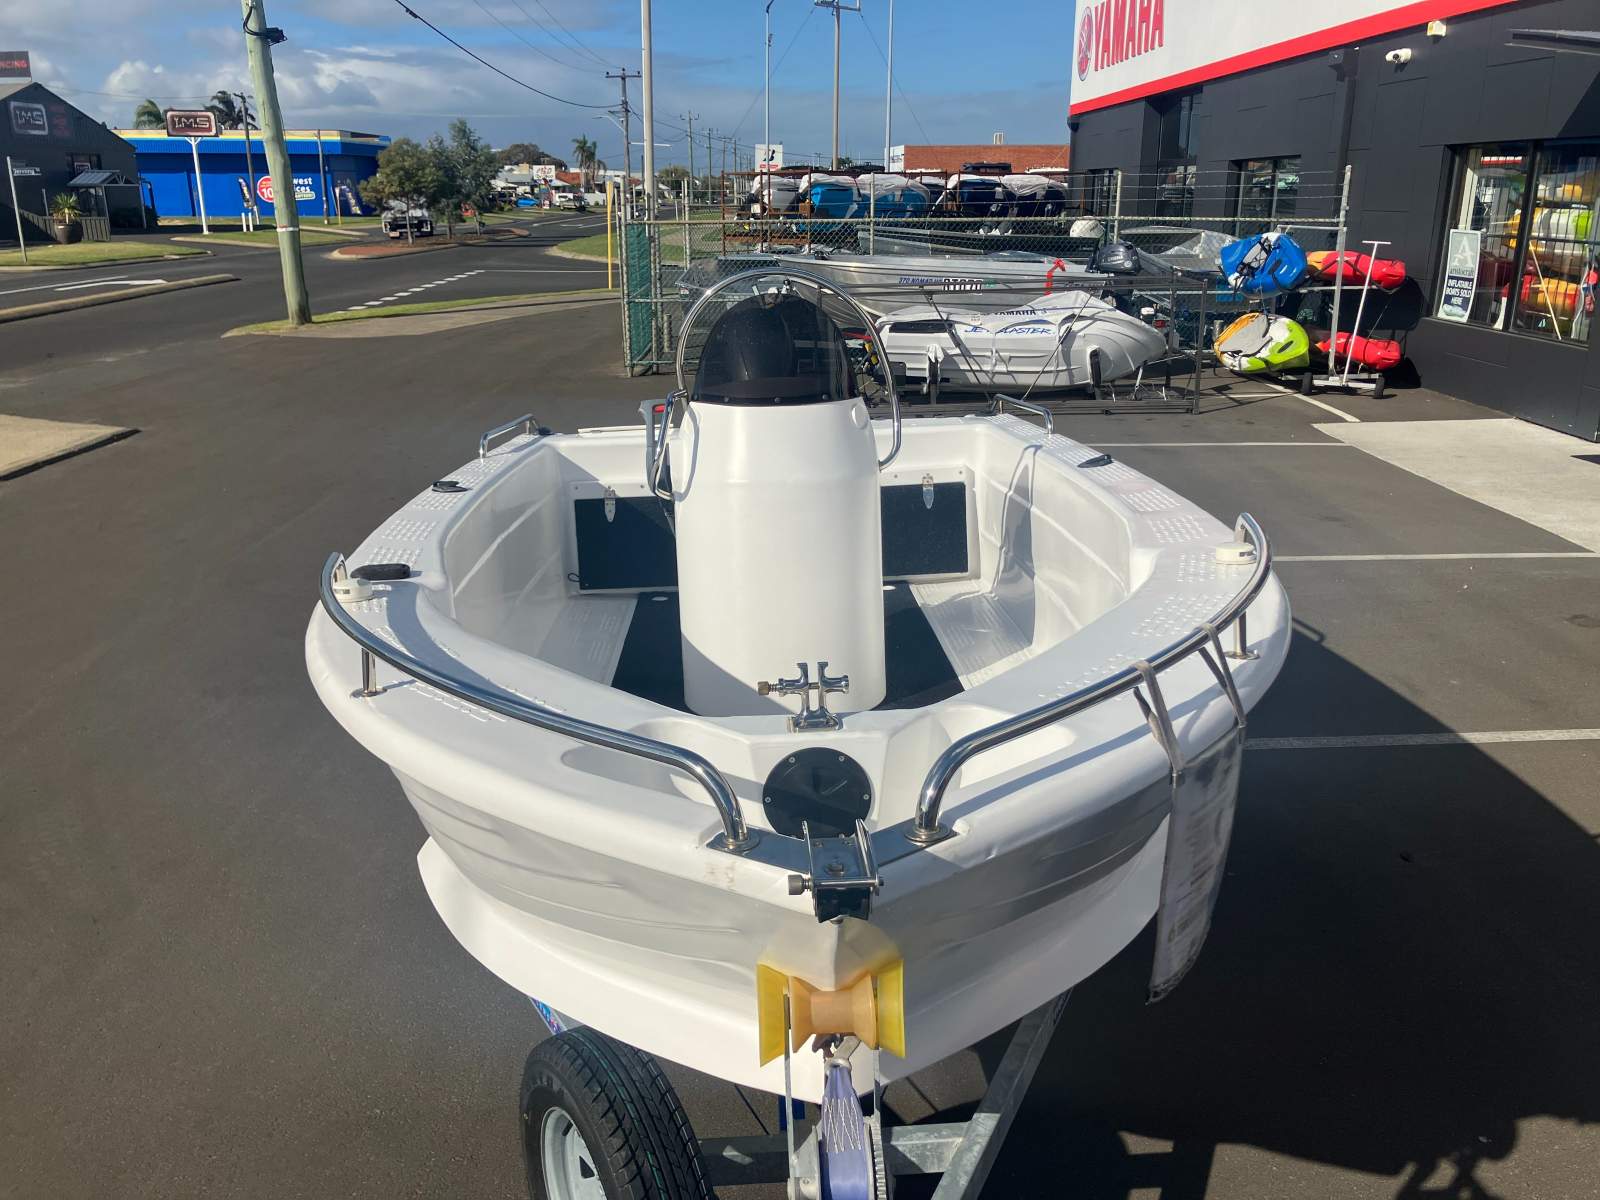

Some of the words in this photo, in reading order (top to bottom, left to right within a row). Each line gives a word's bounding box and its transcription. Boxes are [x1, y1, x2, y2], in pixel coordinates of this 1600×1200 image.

[1094, 0, 1164, 72] YAMAHA
[1447, 279, 1473, 289] INFLATABLE
[1460, 289, 1472, 298] SOLD
